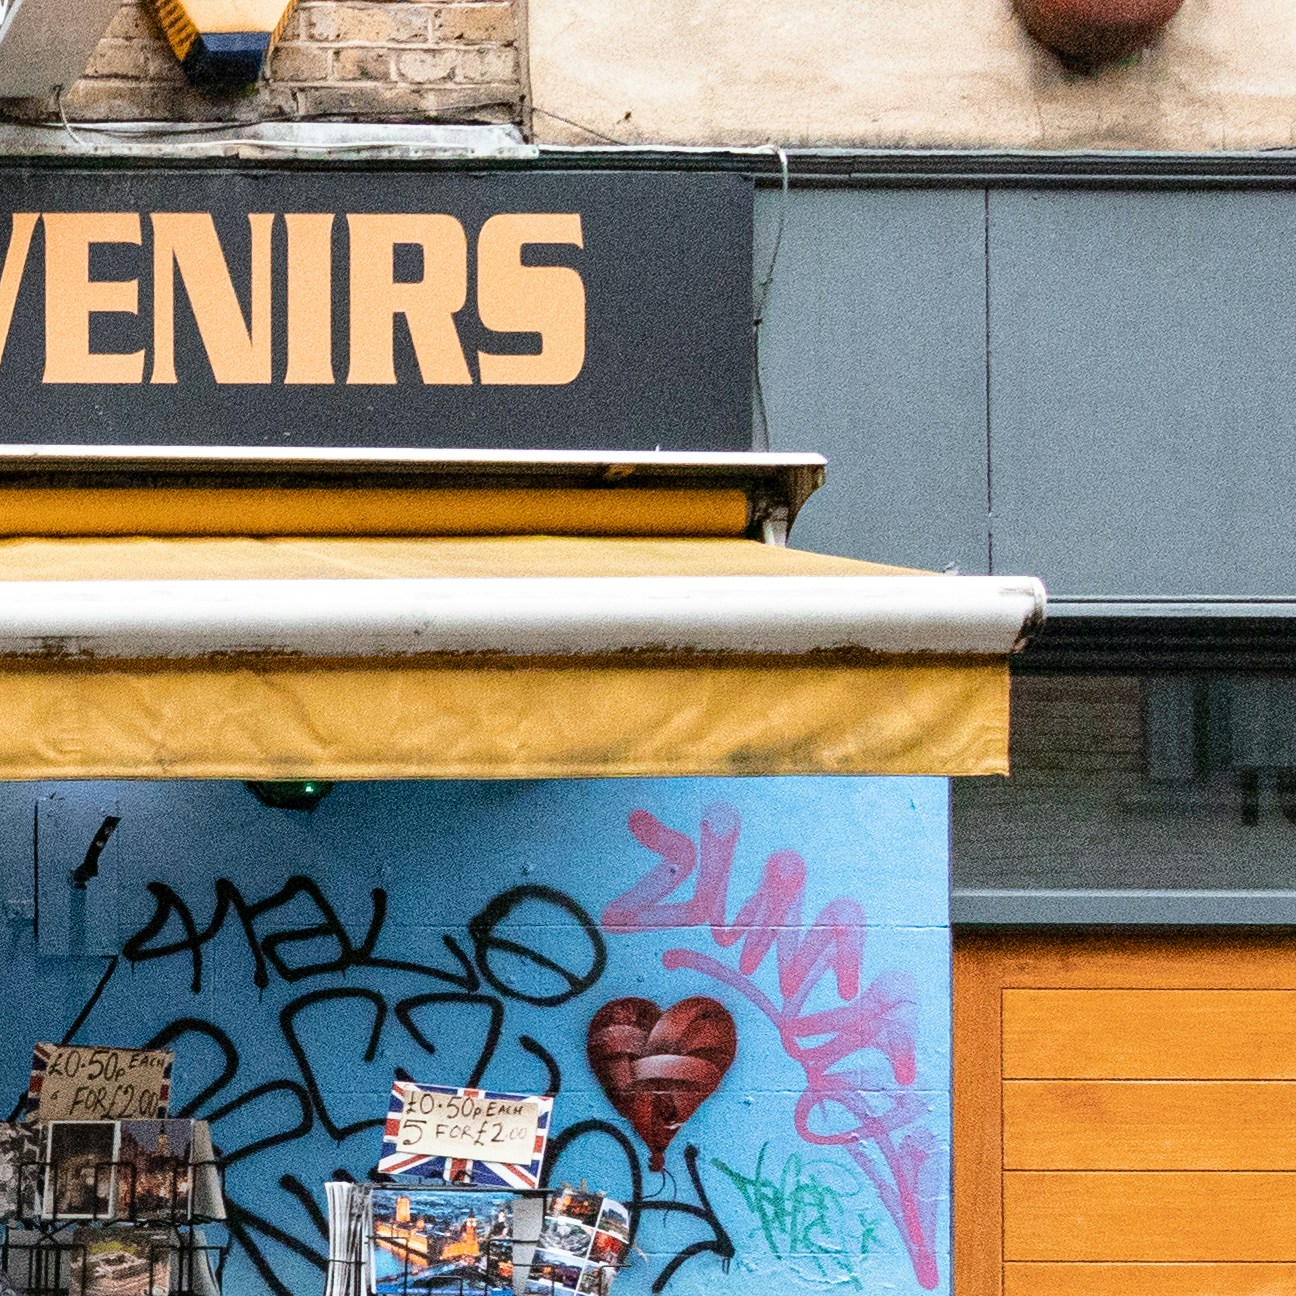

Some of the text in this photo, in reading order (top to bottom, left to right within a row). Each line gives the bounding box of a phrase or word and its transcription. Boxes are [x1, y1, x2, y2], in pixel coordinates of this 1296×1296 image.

[128, 1052, 165, 1070] EACH
[69, 1085, 108, 1116] FOR
[486, 1101, 524, 1117] EACH
[402, 1119, 427, 1147] 5
[435, 1122, 472, 1139] FOR
